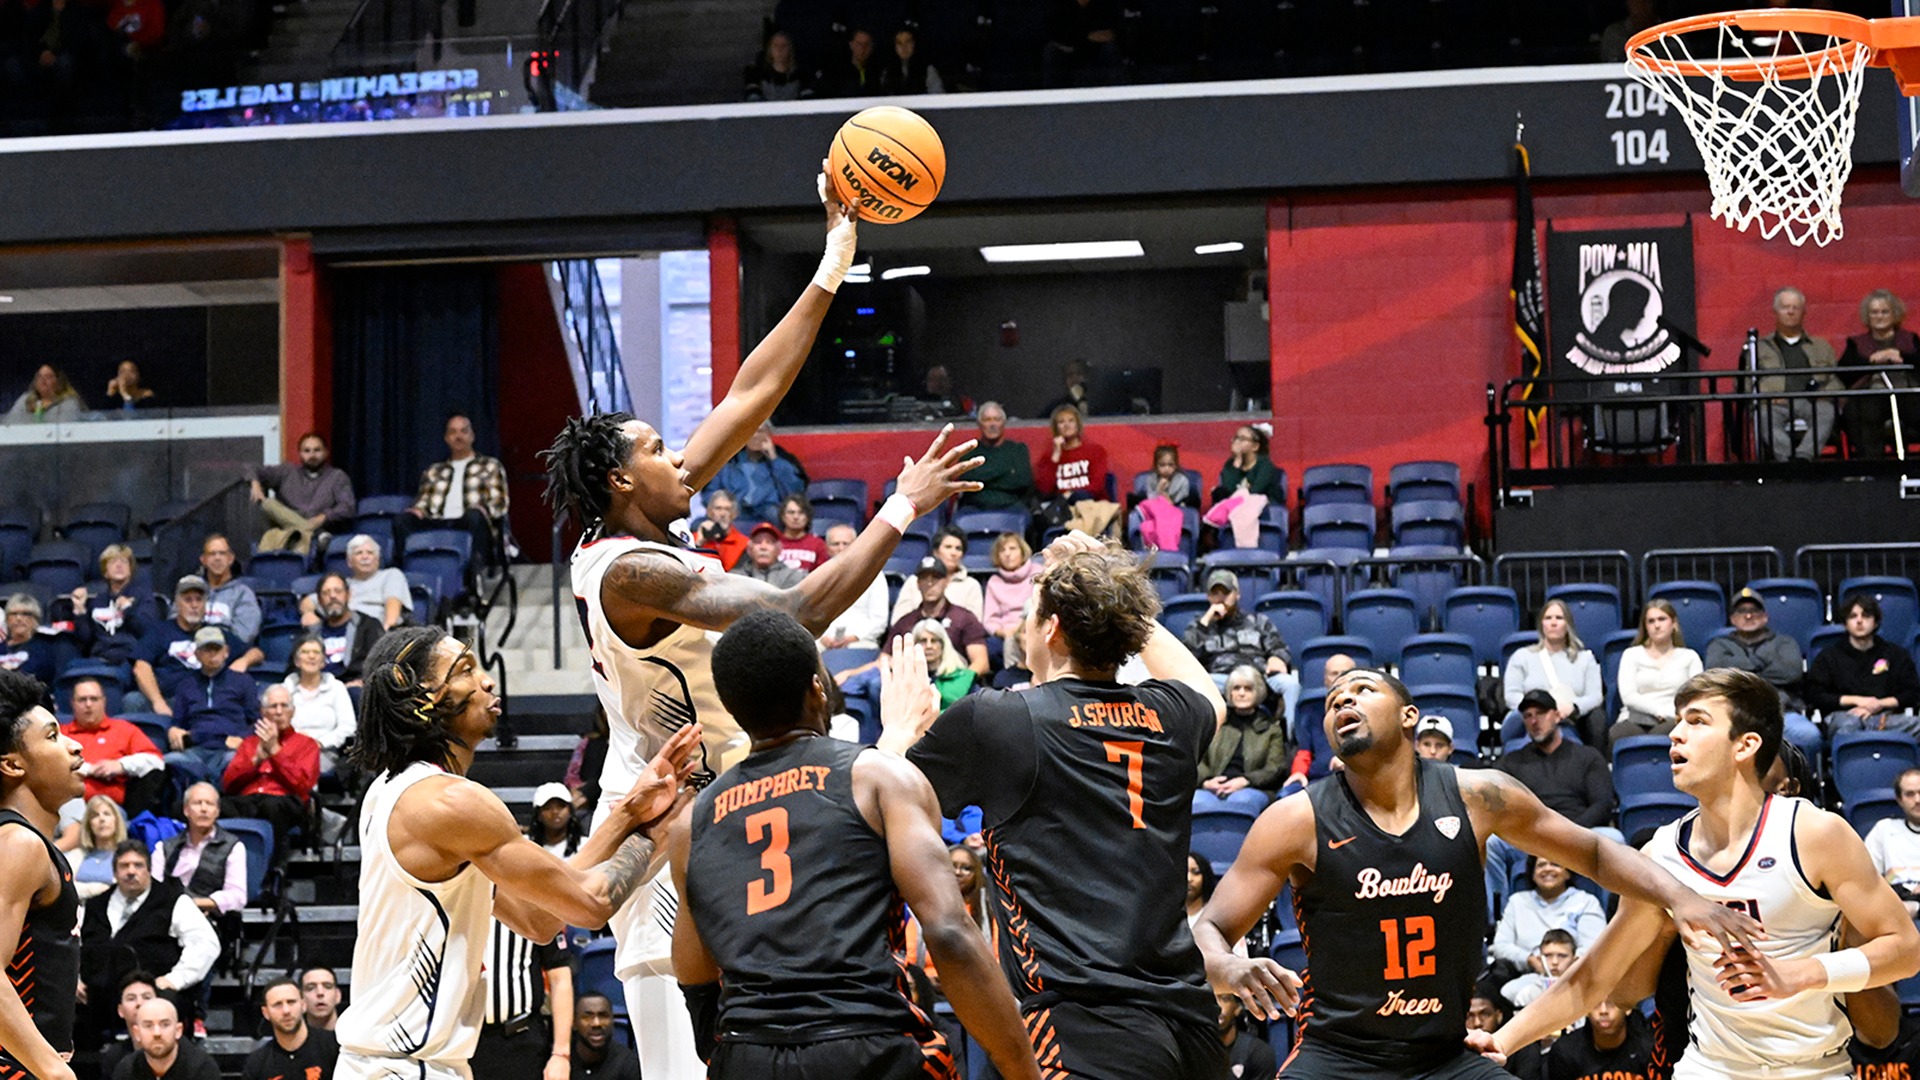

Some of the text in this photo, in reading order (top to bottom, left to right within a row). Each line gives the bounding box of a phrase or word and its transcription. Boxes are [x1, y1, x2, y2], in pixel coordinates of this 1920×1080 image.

[1605, 83, 1668, 118] 204
[867, 147, 919, 191] NCAA
[1611, 129, 1670, 166] 104
[842, 163, 904, 219] Wilson
[1579, 244, 1617, 294] POW
[1627, 242, 1664, 293] MIA
[713, 765, 831, 824] HUMPHREY
[1103, 741, 1147, 829] 7
[745, 806, 793, 916] 3
[1355, 862, 1453, 903] Bowling
[1380, 915, 1436, 980] 12
[1376, 989, 1443, 1016] Green
